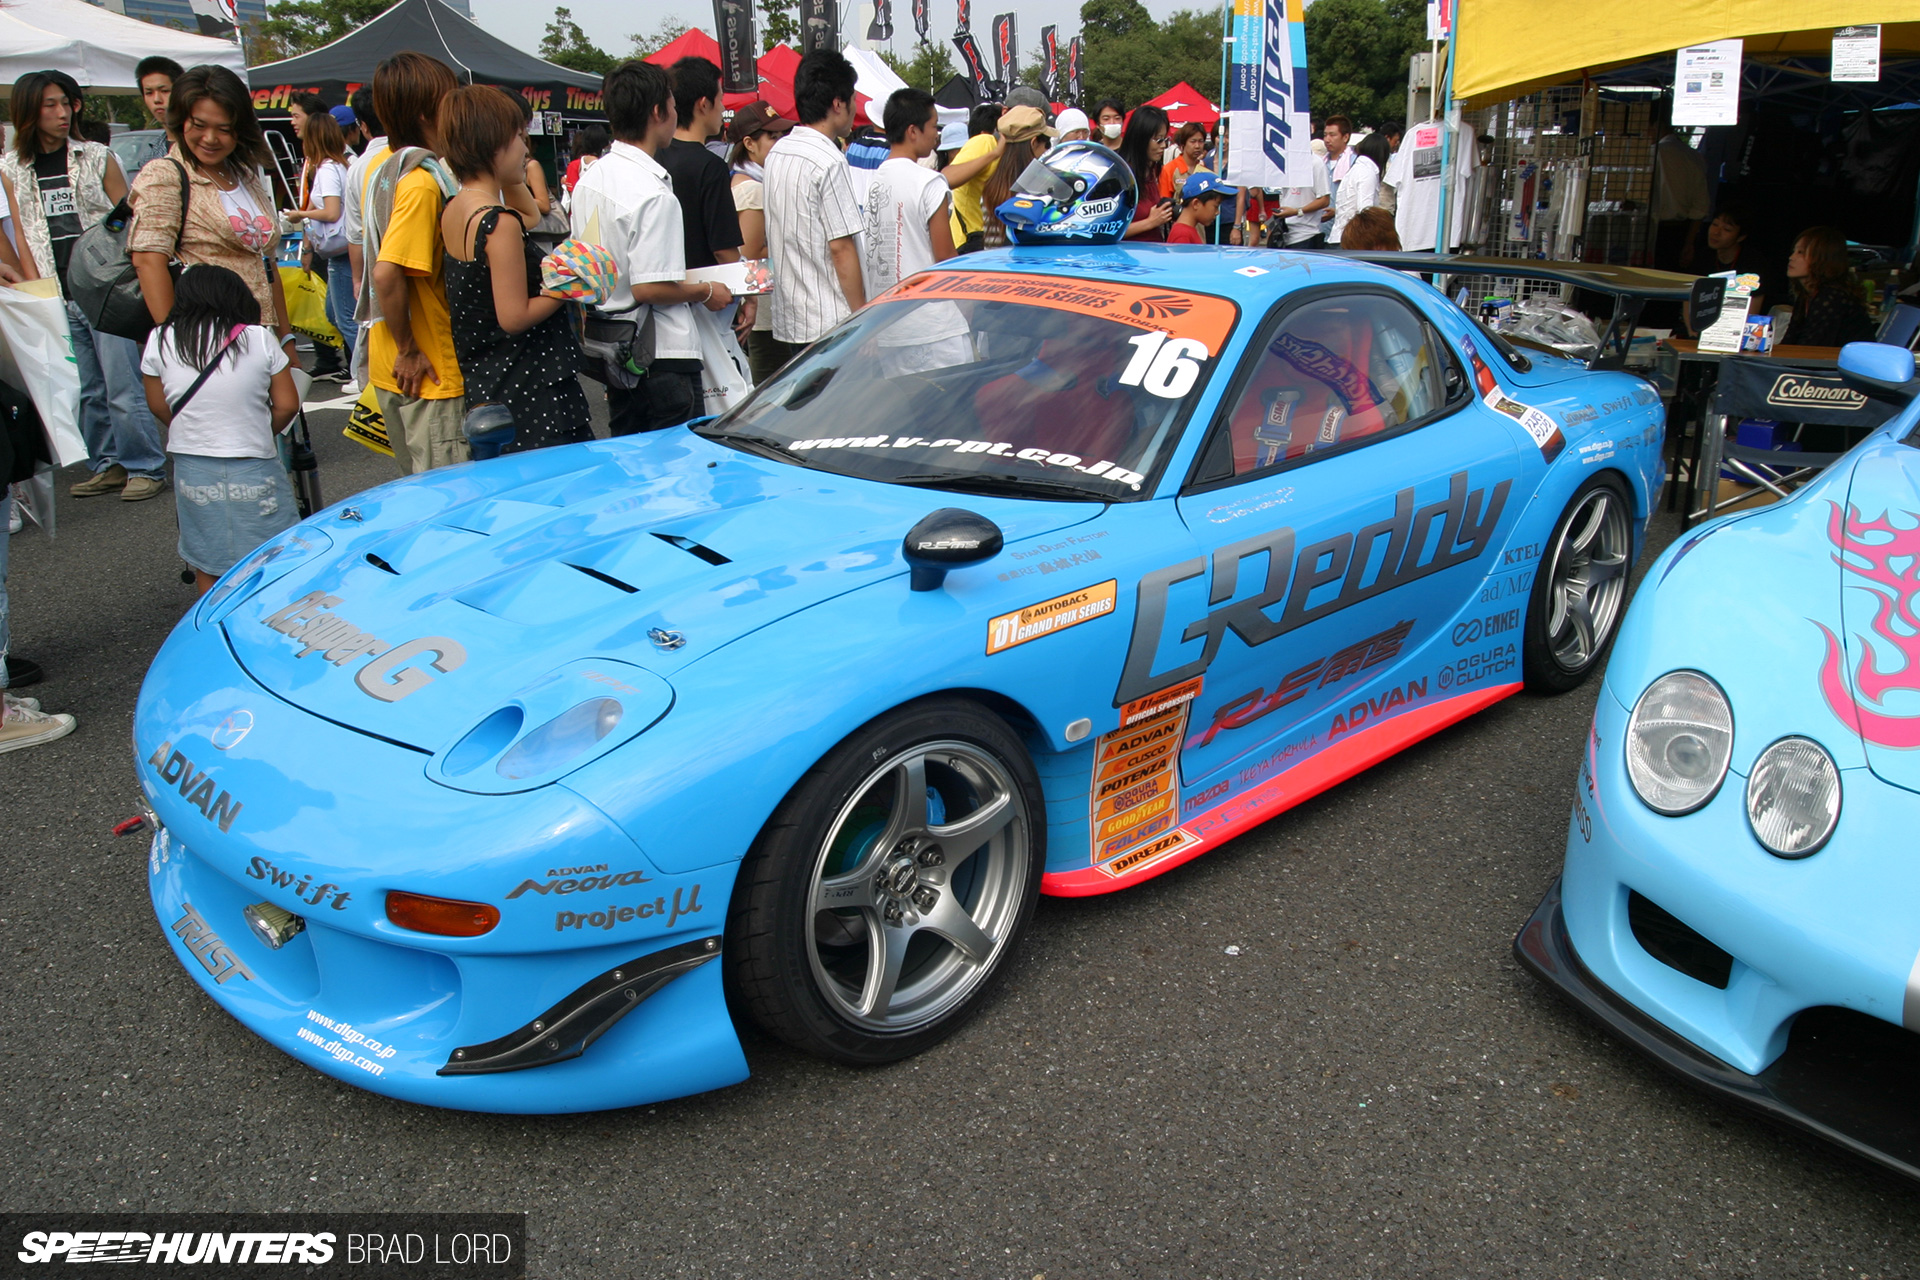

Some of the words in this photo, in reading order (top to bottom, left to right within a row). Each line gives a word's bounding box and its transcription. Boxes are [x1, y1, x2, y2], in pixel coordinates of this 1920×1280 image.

[566, 87, 605, 111] Tiref
[1082, 201, 1113, 216] SHOEI
[951, 283, 1012, 295] GRAND
[1003, 285, 1053, 299] PRIX
[1045, 290, 1117, 309] SERIES
[979, 277, 1077, 290] PROFESSIONAL
[1077, 286, 1125, 298] DRIFT
[1105, 312, 1178, 335] AUTOBACS
[1118, 330, 1209, 399] 16
[1778, 378, 1851, 401] Coleman
[1602, 396, 1633, 416] Swift
[1504, 543, 1541, 565] KTEL
[1111, 470, 1513, 709] GReddy
[1033, 593, 1088, 617] AUTOBACS
[994, 615, 1019, 648] D1
[1018, 617, 1053, 640] GRAND
[1054, 609, 1078, 627] PRIX
[1079, 597, 1112, 619] SERIES
[1484, 608, 1520, 637] ENKEI
[1456, 657, 1516, 686] CLUTCH
[1457, 643, 1516, 671] OGURA
[1126, 706, 1157, 725] OFFICIAL
[1157, 691, 1195, 712] SPONSORS
[1327, 676, 1428, 741] ADVAN
[1117, 722, 1176, 754] ADVAN
[1127, 745, 1166, 767] CUSCO
[1238, 759, 1270, 786] IKEYA
[1271, 733, 1318, 768] FORMULA
[148, 741, 244, 834] ADVAN
[1100, 758, 1167, 796] POTENZA
[1124, 780, 1158, 799] OGURA
[1124, 787, 1159, 808] CLUTCH
[1105, 815, 1169, 854] FALKEN
[1112, 835, 1183, 871] DIREZZA
[246, 856, 352, 911] Swift
[504, 870, 653, 899] Neova
[546, 863, 609, 877] ADVAN
[555, 897, 666, 932] project
[171, 902, 256, 985] TRUST
